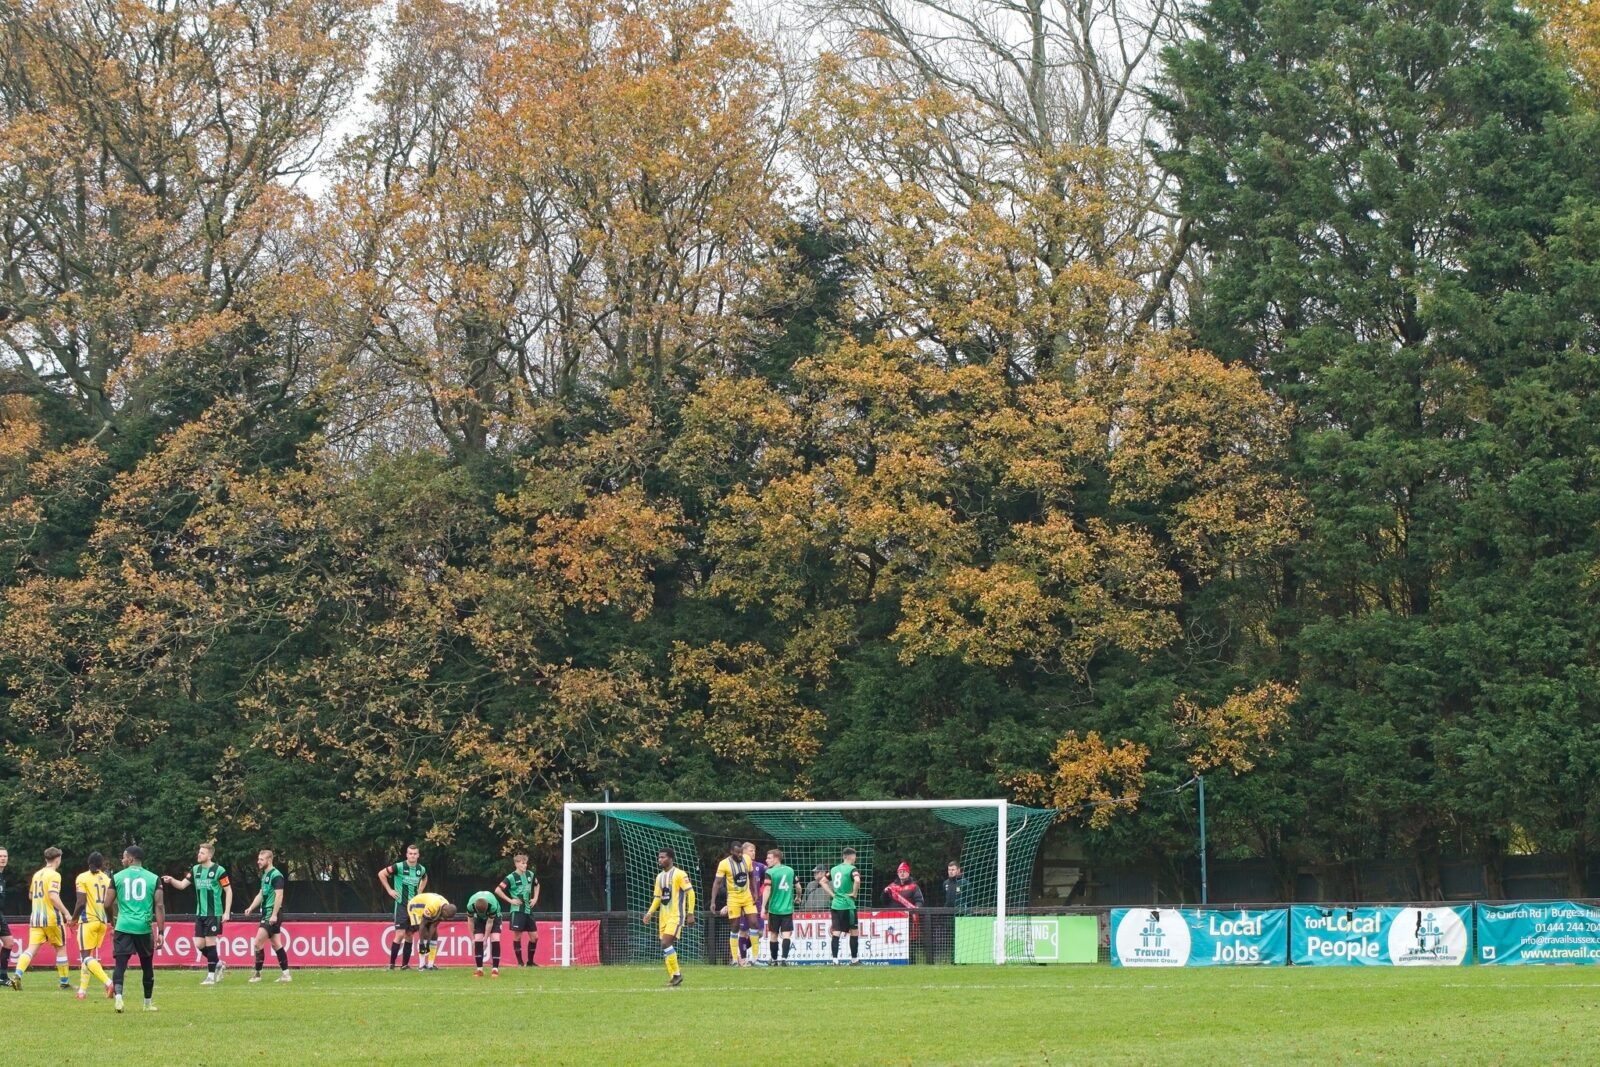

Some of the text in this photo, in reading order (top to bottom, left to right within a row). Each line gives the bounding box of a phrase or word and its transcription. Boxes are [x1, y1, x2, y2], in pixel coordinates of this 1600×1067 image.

[33, 880, 45, 898] 13
[123, 877, 147, 901] 10
[778, 874, 790, 891] 4
[833, 872, 842, 888] 8
[1327, 912, 1380, 933] Local
[1529, 908, 1541, 918] Rd
[1551, 908, 1585, 919] Burgess
[1209, 915, 1262, 936] Local
[1535, 923, 1564, 932] 01444
[1566, 922, 1584, 932] 244
[271, 926, 370, 957] Double
[1212, 940, 1260, 961] Jobs
[1307, 936, 1380, 960] People
[1134, 948, 1171, 957] Travail
